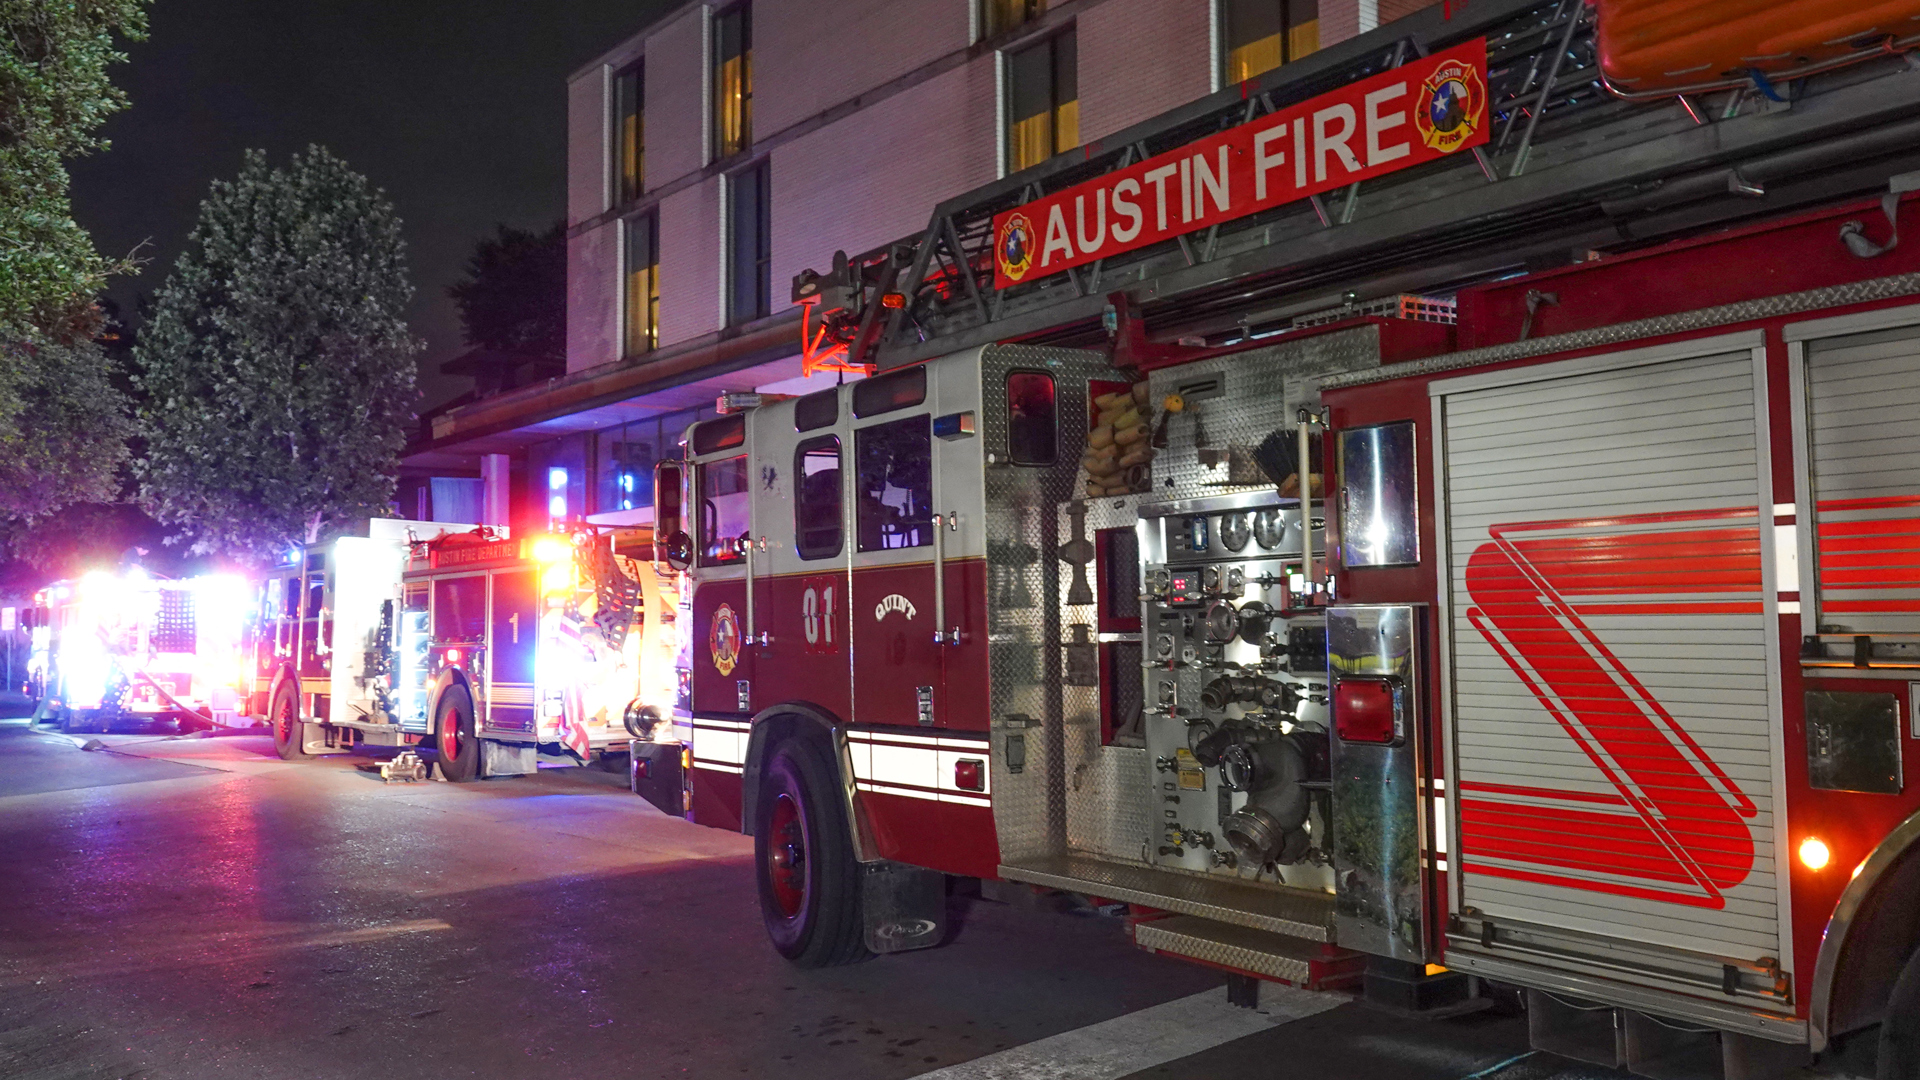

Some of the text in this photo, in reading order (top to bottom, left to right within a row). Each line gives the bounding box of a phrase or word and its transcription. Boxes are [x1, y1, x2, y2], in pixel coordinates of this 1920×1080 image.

[1435, 67, 1462, 84] AUSTIN
[1438, 130, 1463, 146] FIRE
[1040, 80, 1411, 268] AUSTIN FIRE
[802, 586, 833, 645] 01
[875, 593, 917, 622] QUINT
[508, 612, 519, 644] 1
[139, 685, 155, 696] 13
